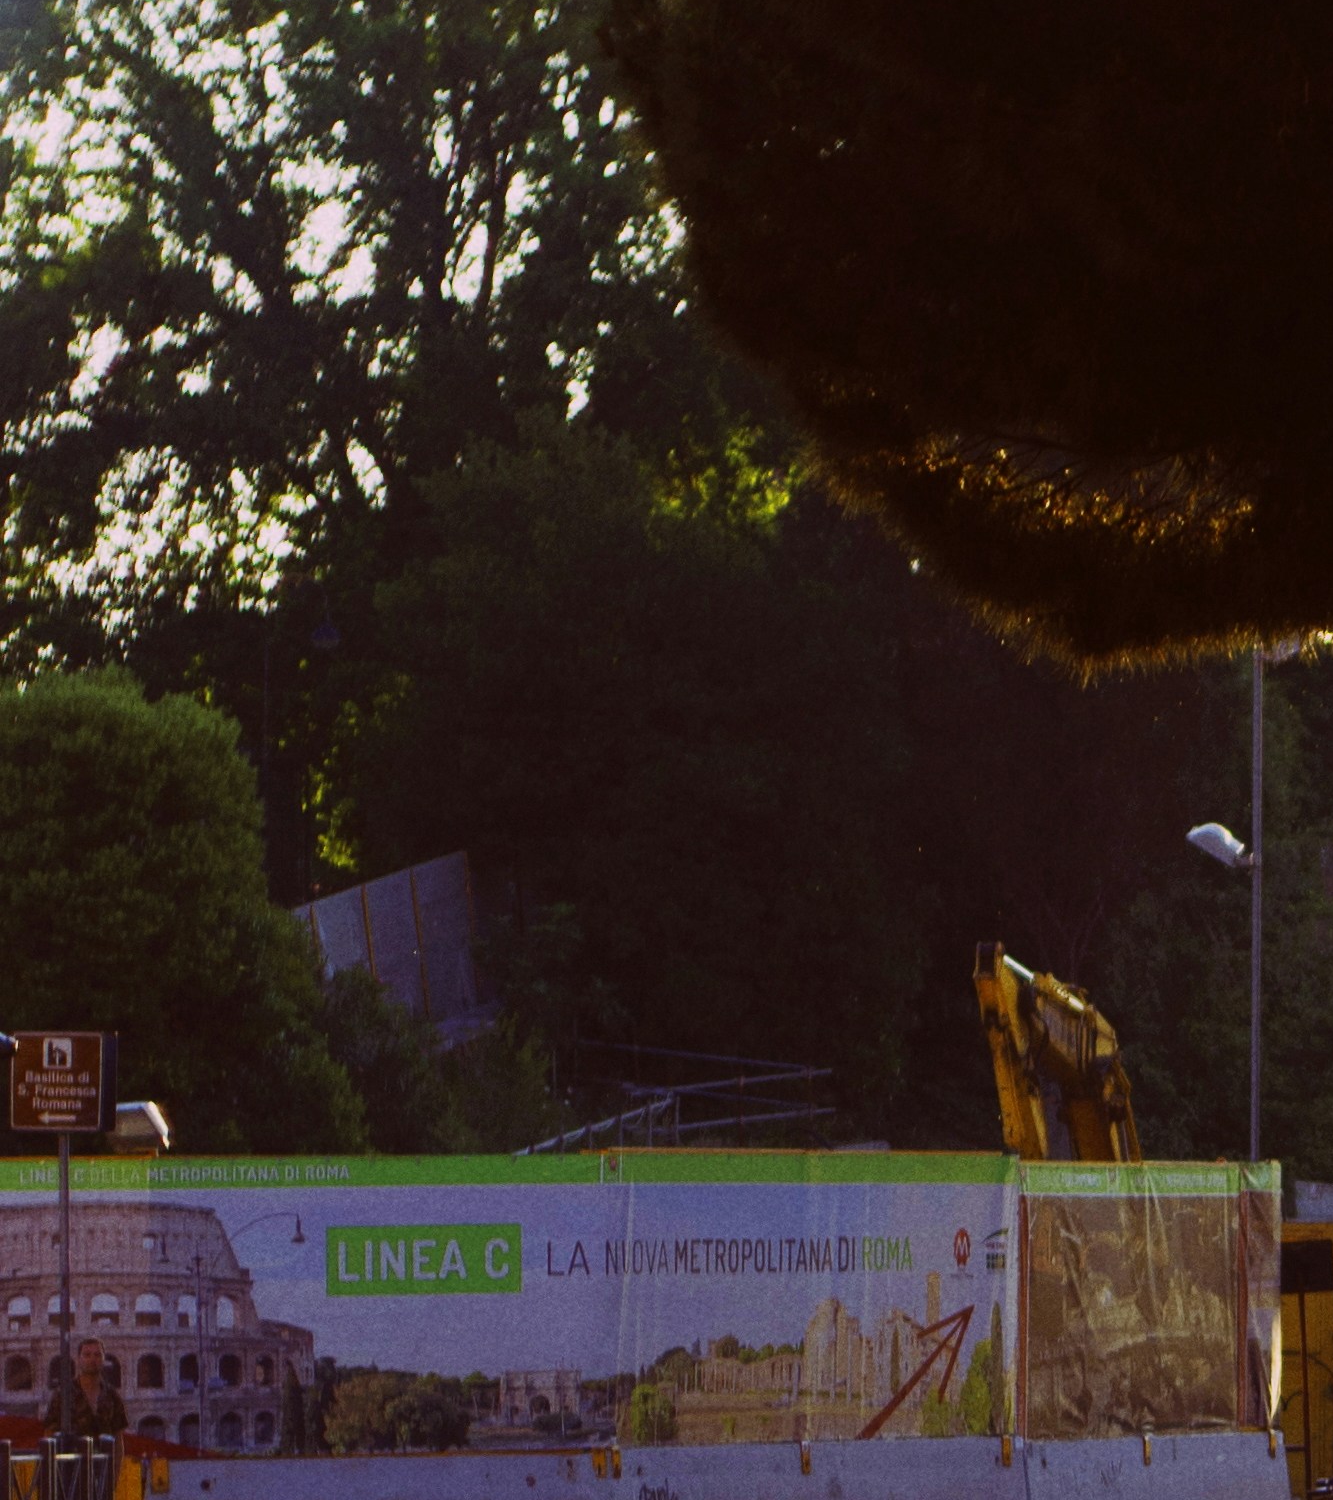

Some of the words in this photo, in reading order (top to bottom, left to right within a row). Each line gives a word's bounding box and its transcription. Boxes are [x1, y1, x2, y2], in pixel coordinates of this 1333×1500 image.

[25, 1069, 74, 1083] Basilica
[78, 1070, 90, 1084] di
[17, 1082, 30, 1097] S.
[34, 1083, 97, 1098] Francesca
[32, 1096, 82, 1110] Romana
[146, 1165, 281, 1182] METROPOLITANA
[284, 1165, 300, 1181] DI
[305, 1164, 350, 1180] ROMA
[337, 1238, 469, 1283] LINEA
[484, 1238, 510, 1280] C
[546, 1239, 590, 1277] LA
[605, 1238, 669, 1276] NUOVA
[674, 1236, 833, 1275] METROPOLITANA
[837, 1236, 856, 1272] DI
[862, 1236, 913, 1272] ROMA
